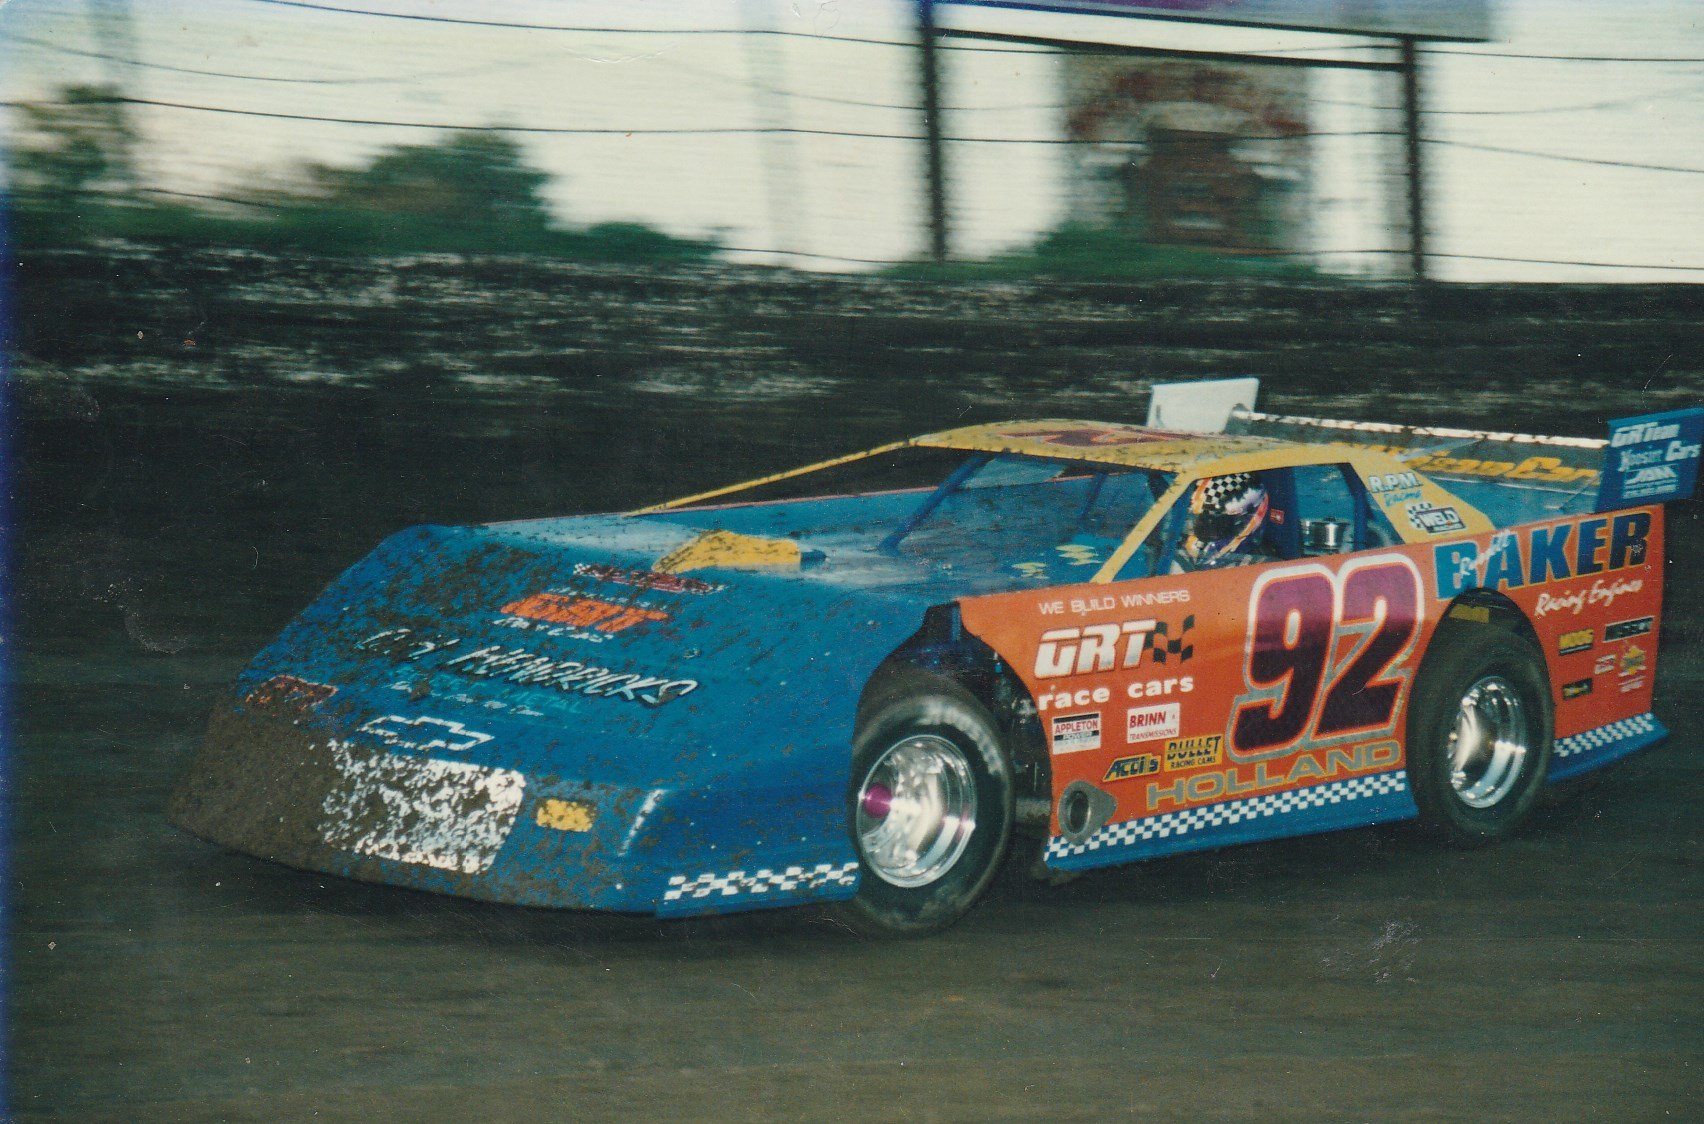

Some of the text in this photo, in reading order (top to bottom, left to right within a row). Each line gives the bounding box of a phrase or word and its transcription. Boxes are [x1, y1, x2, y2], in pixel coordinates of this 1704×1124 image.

[1419, 509, 1457, 527] WELD
[1433, 511, 1652, 601] BAKER
[1038, 589, 1191, 615] WE BUILD WINNERS
[1534, 591, 1586, 616] Racing
[1034, 618, 1157, 680] GRT
[1225, 553, 1424, 764] 92
[447, 644, 699, 704] HENDRICKS
[1037, 676, 1195, 711] race cars
[1054, 719, 1099, 735] APPLETON
[1129, 711, 1167, 729] BRINN
[1129, 728, 1177, 741] TRANSMISSIONS
[1167, 736, 1222, 761] BULLET
[1145, 739, 1402, 810] HOLLAND
[1170, 758, 1195, 769] RACING
